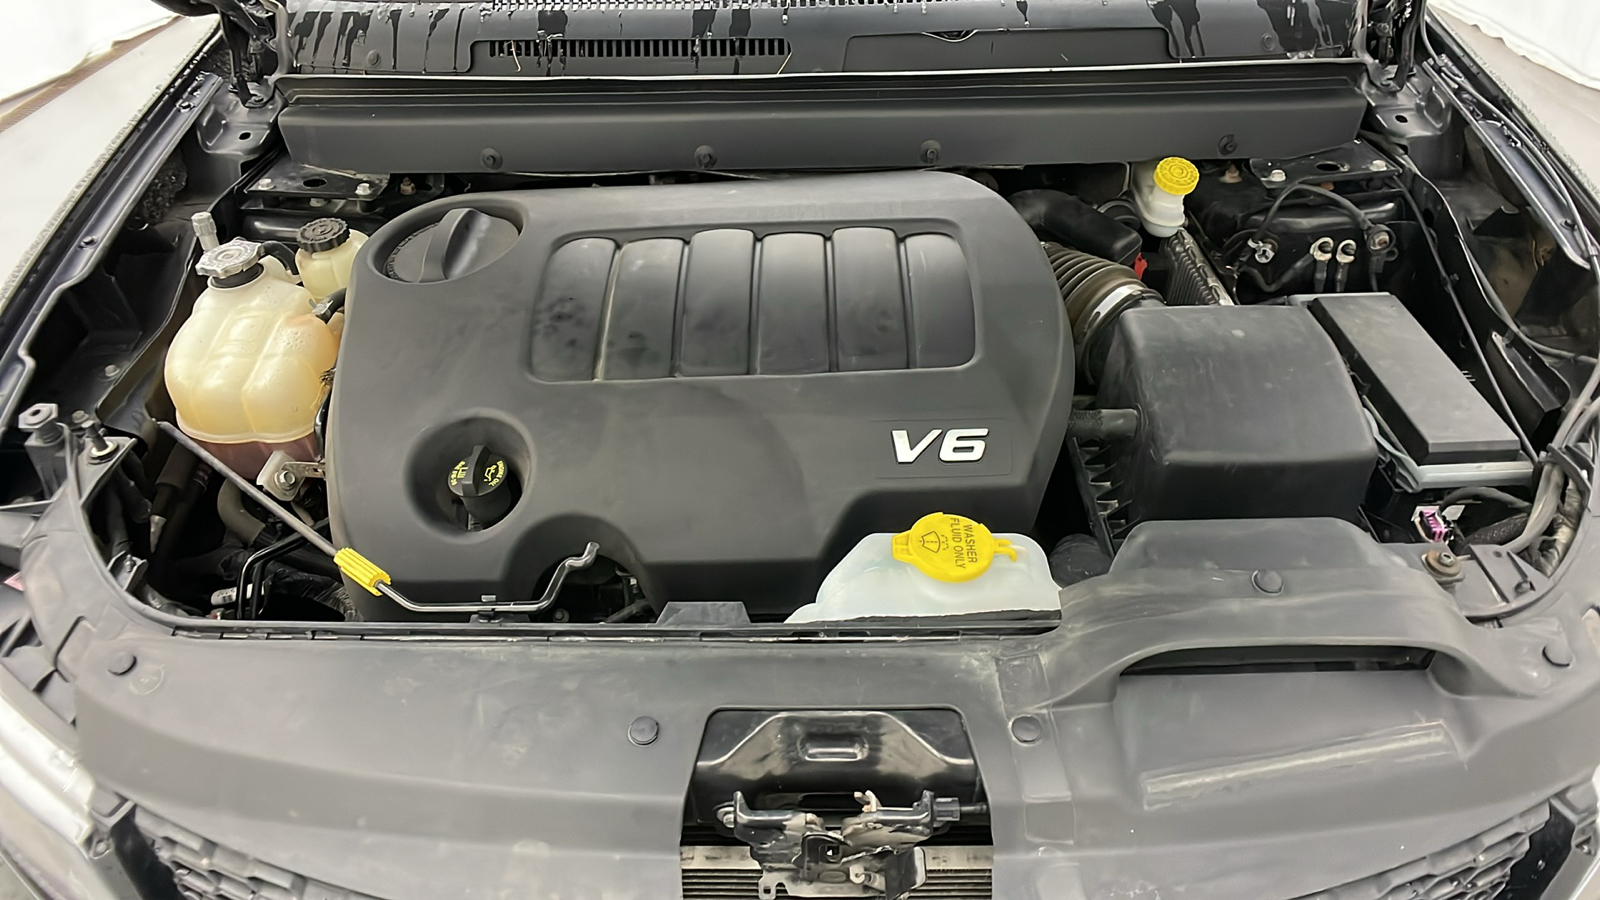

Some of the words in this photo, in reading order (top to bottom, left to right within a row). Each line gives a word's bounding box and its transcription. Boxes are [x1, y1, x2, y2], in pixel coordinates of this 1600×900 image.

[891, 428, 989, 463] V6
[950, 517, 961, 543] FLUID
[963, 524, 978, 563] WASHER
[954, 545, 966, 569] ONLY
